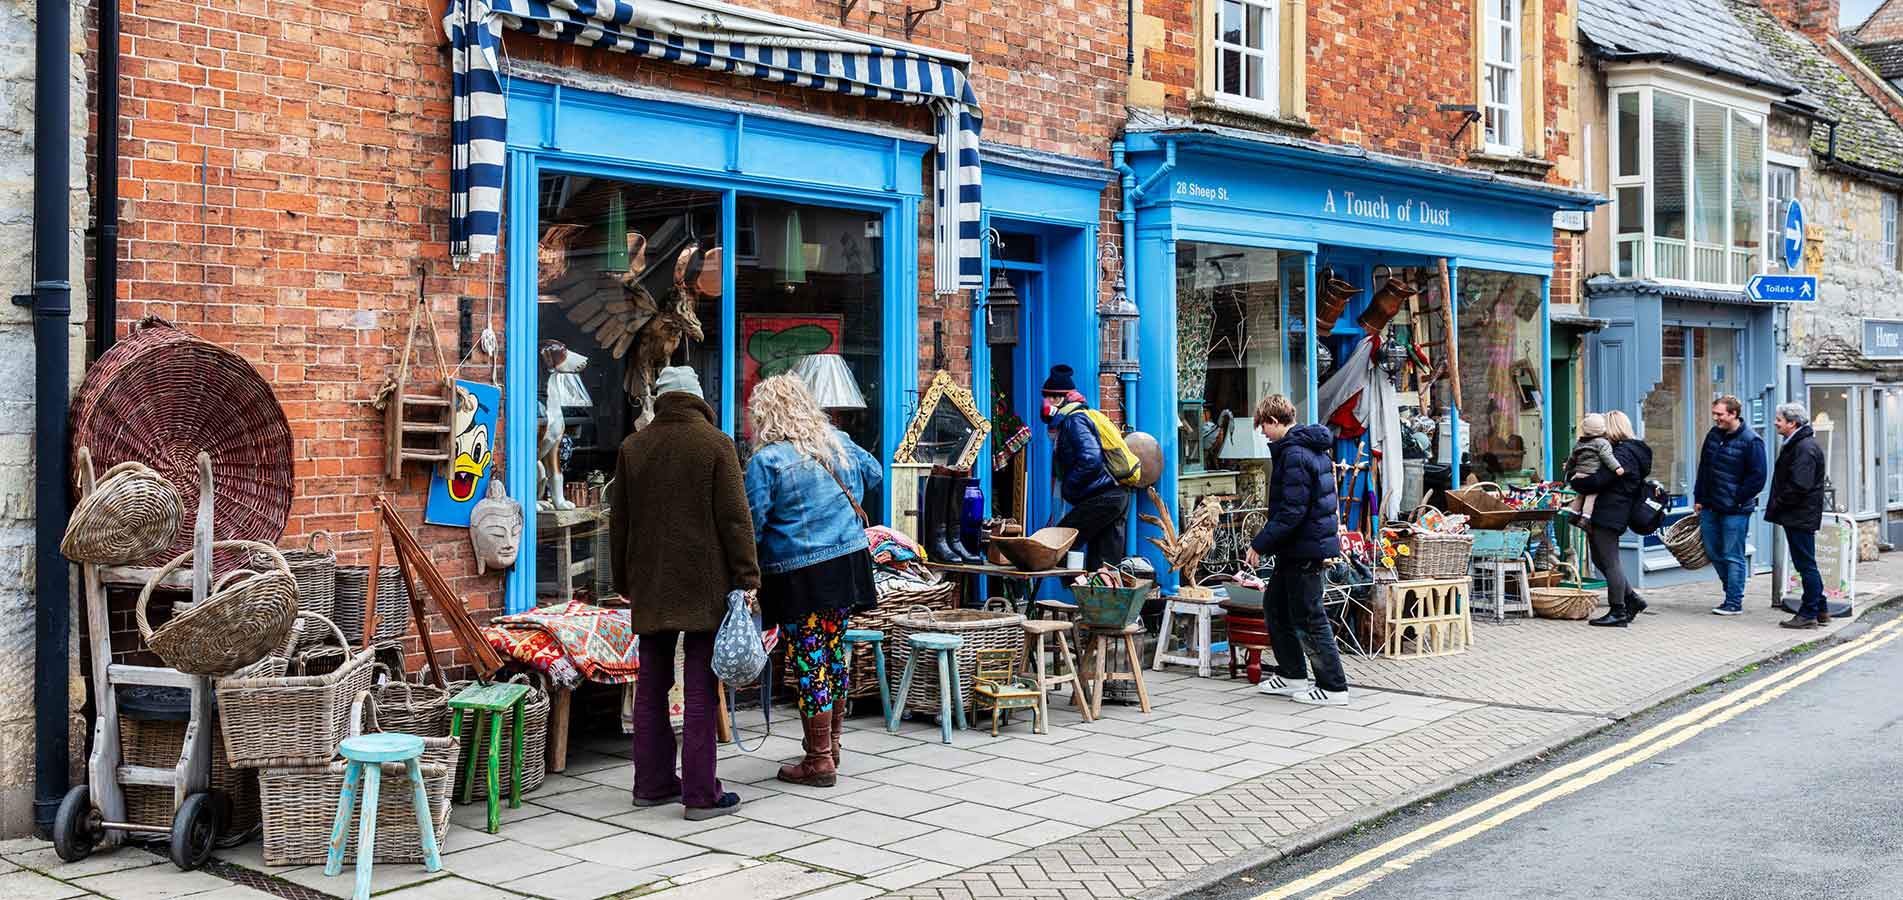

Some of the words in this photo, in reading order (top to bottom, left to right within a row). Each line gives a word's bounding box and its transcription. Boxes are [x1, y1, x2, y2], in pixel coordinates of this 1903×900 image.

[1176, 181, 1187, 194] 28
[1189, 183, 1216, 200] Sheep
[1217, 187, 1230, 200] St.
[1324, 189, 1336, 213] A
[1343, 191, 1390, 220] Touch
[1397, 199, 1413, 222] of
[1420, 201, 1450, 226] Dust
[1764, 284, 1794, 293] Toilets
[1875, 327, 1899, 347] Home
